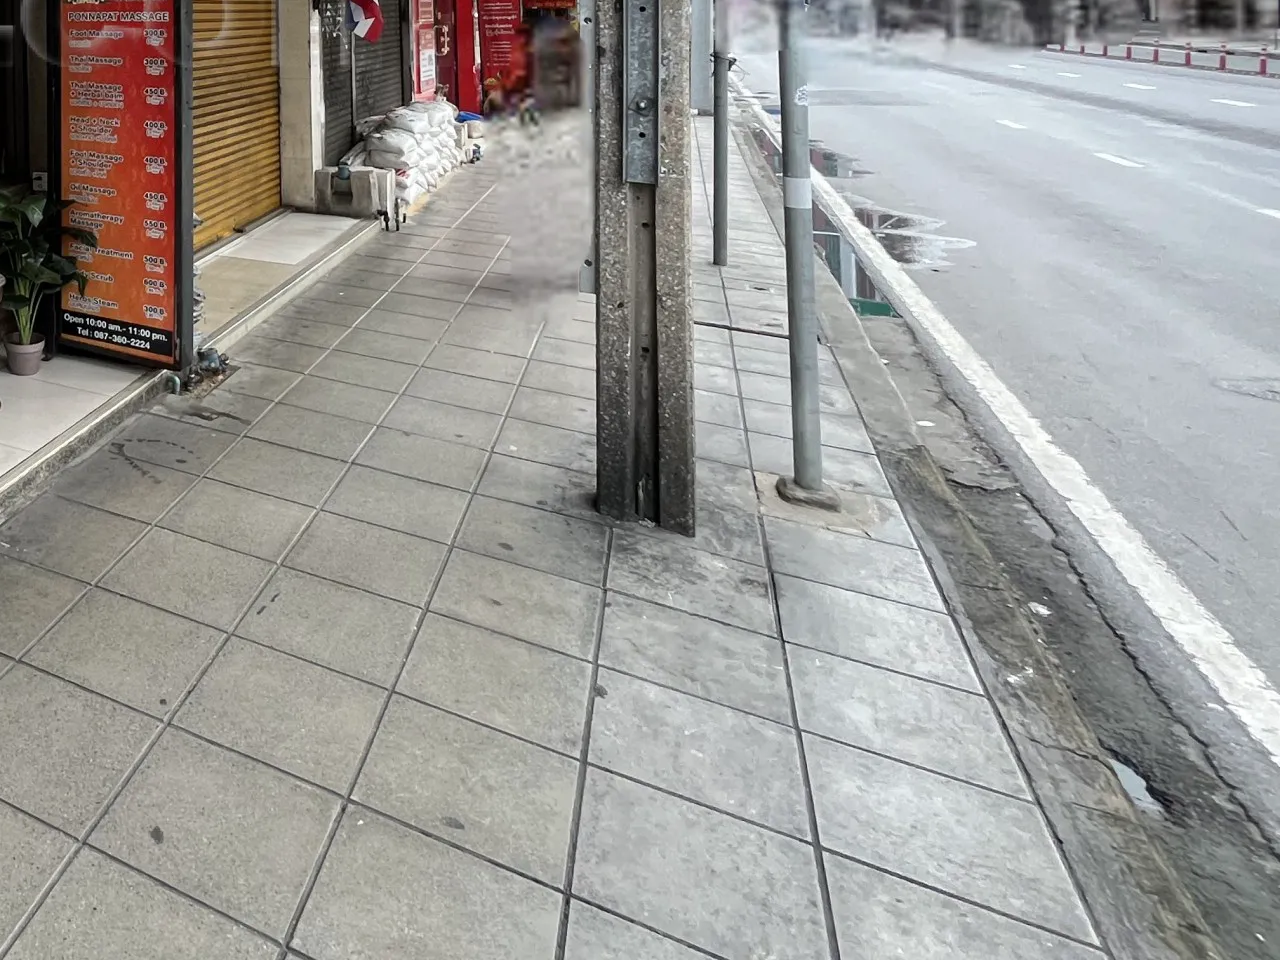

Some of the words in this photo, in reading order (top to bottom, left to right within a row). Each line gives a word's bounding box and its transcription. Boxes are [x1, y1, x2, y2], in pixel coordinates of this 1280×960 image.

[68, 11, 119, 22] PONNAPAT
[120, 11, 170, 22] MASSAGE
[70, 29, 87, 38] Foot
[87, 56, 123, 66] Massage
[87, 82, 122, 93] Massage
[89, 152, 124, 163] Massage
[78, 159, 112, 169] Shoulder
[82, 185, 117, 197] Massage
[70, 209, 124, 225] Aromatherapy
[70, 217, 104, 229] Massage
[90, 271, 114, 283] Scrub
[93, 297, 119, 309] Steam
[63, 313, 84, 325] Open
[86, 318, 107, 329] 10:00
[128, 327, 151, 338] 11:00
[152, 332, 168, 342] pm.
[76, 326, 89, 337] Tel
[94, 331, 151, 350] 087-360-2224
